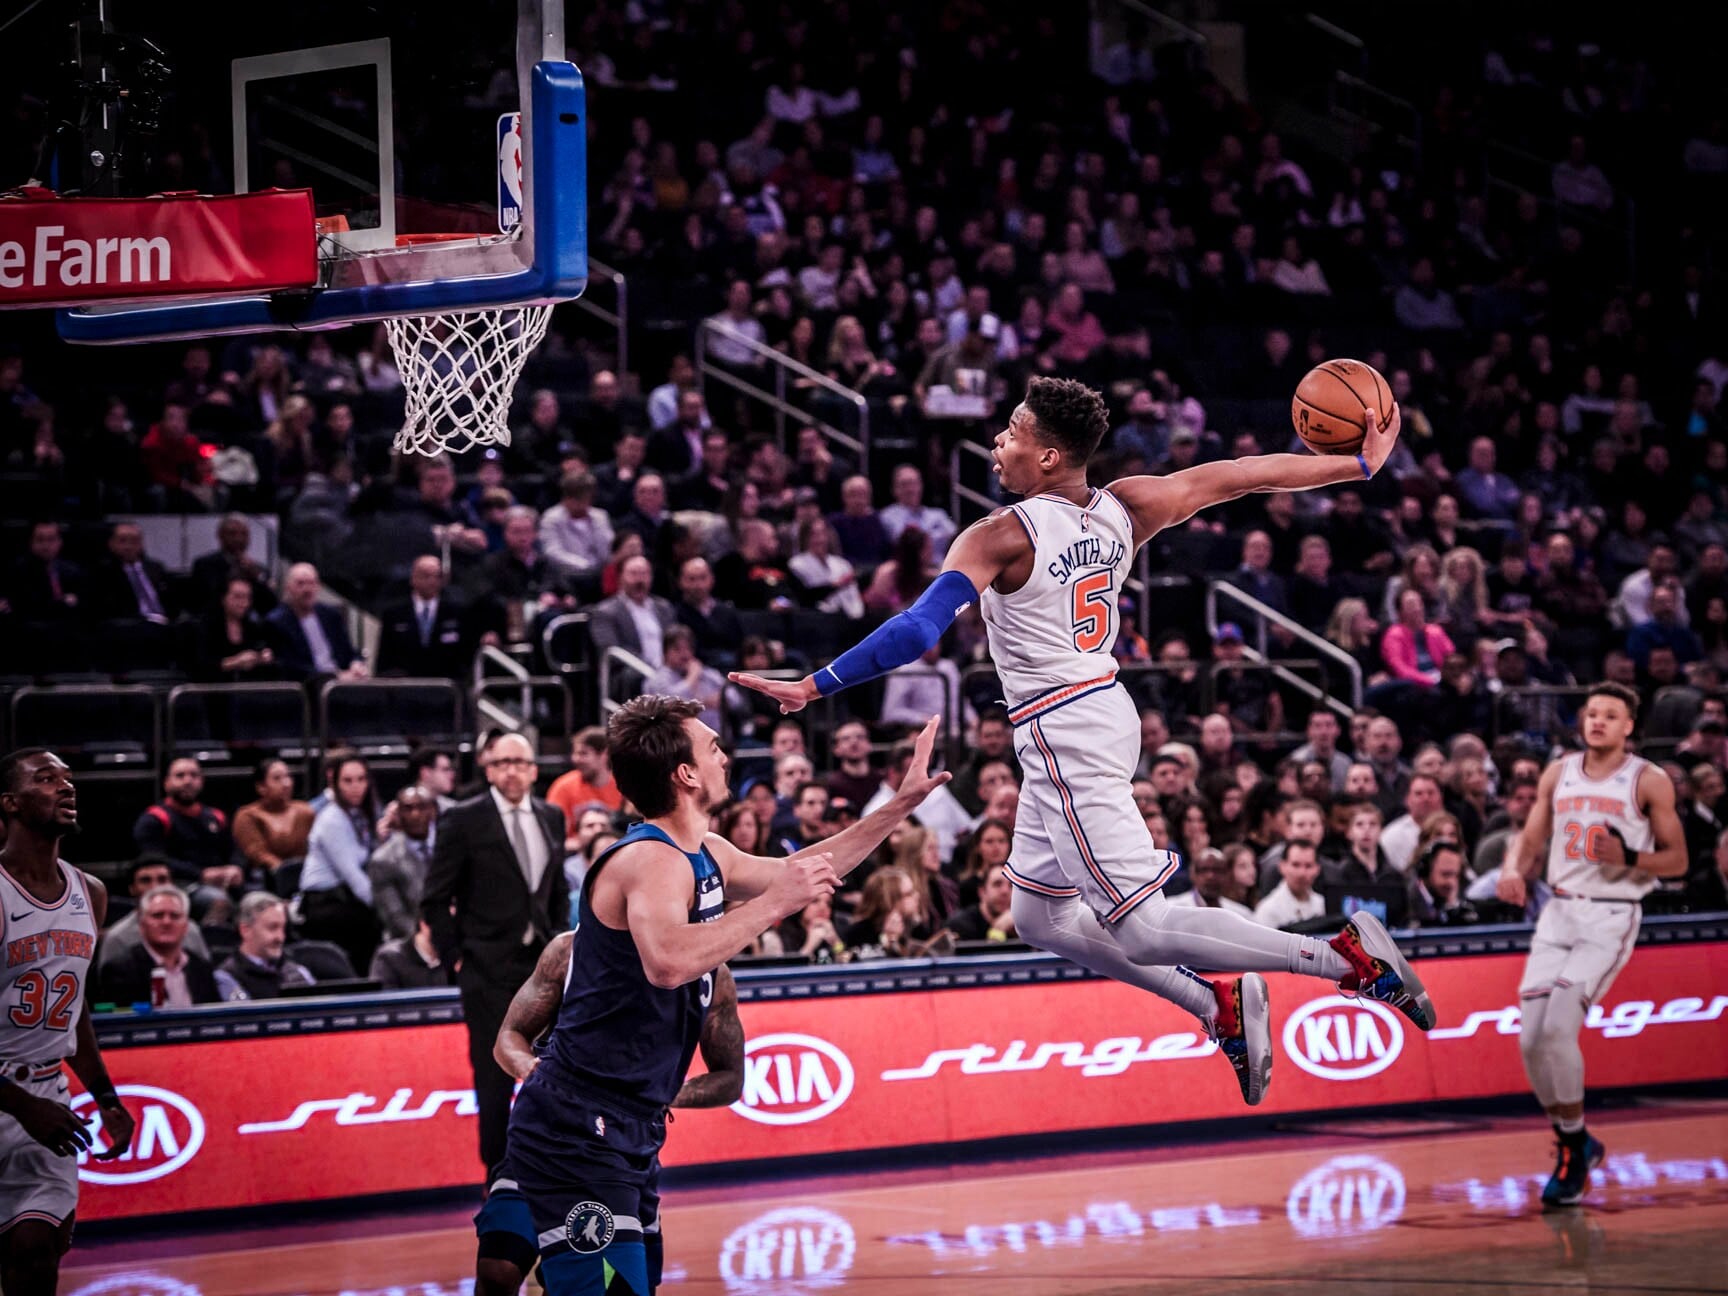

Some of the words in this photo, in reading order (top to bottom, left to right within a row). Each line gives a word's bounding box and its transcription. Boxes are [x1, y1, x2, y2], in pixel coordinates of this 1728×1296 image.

[503, 206, 519, 226] NBA
[1048, 538, 1100, 585] SMITH
[1071, 567, 1113, 653] 5
[50, 929, 94, 961] YORK
[8, 968, 79, 1032] 32
[880, 1032, 1219, 1078] stinge
[1303, 1011, 1387, 1063] KIA
[743, 1052, 834, 1107] KIA
[72, 1105, 180, 1165] KA
